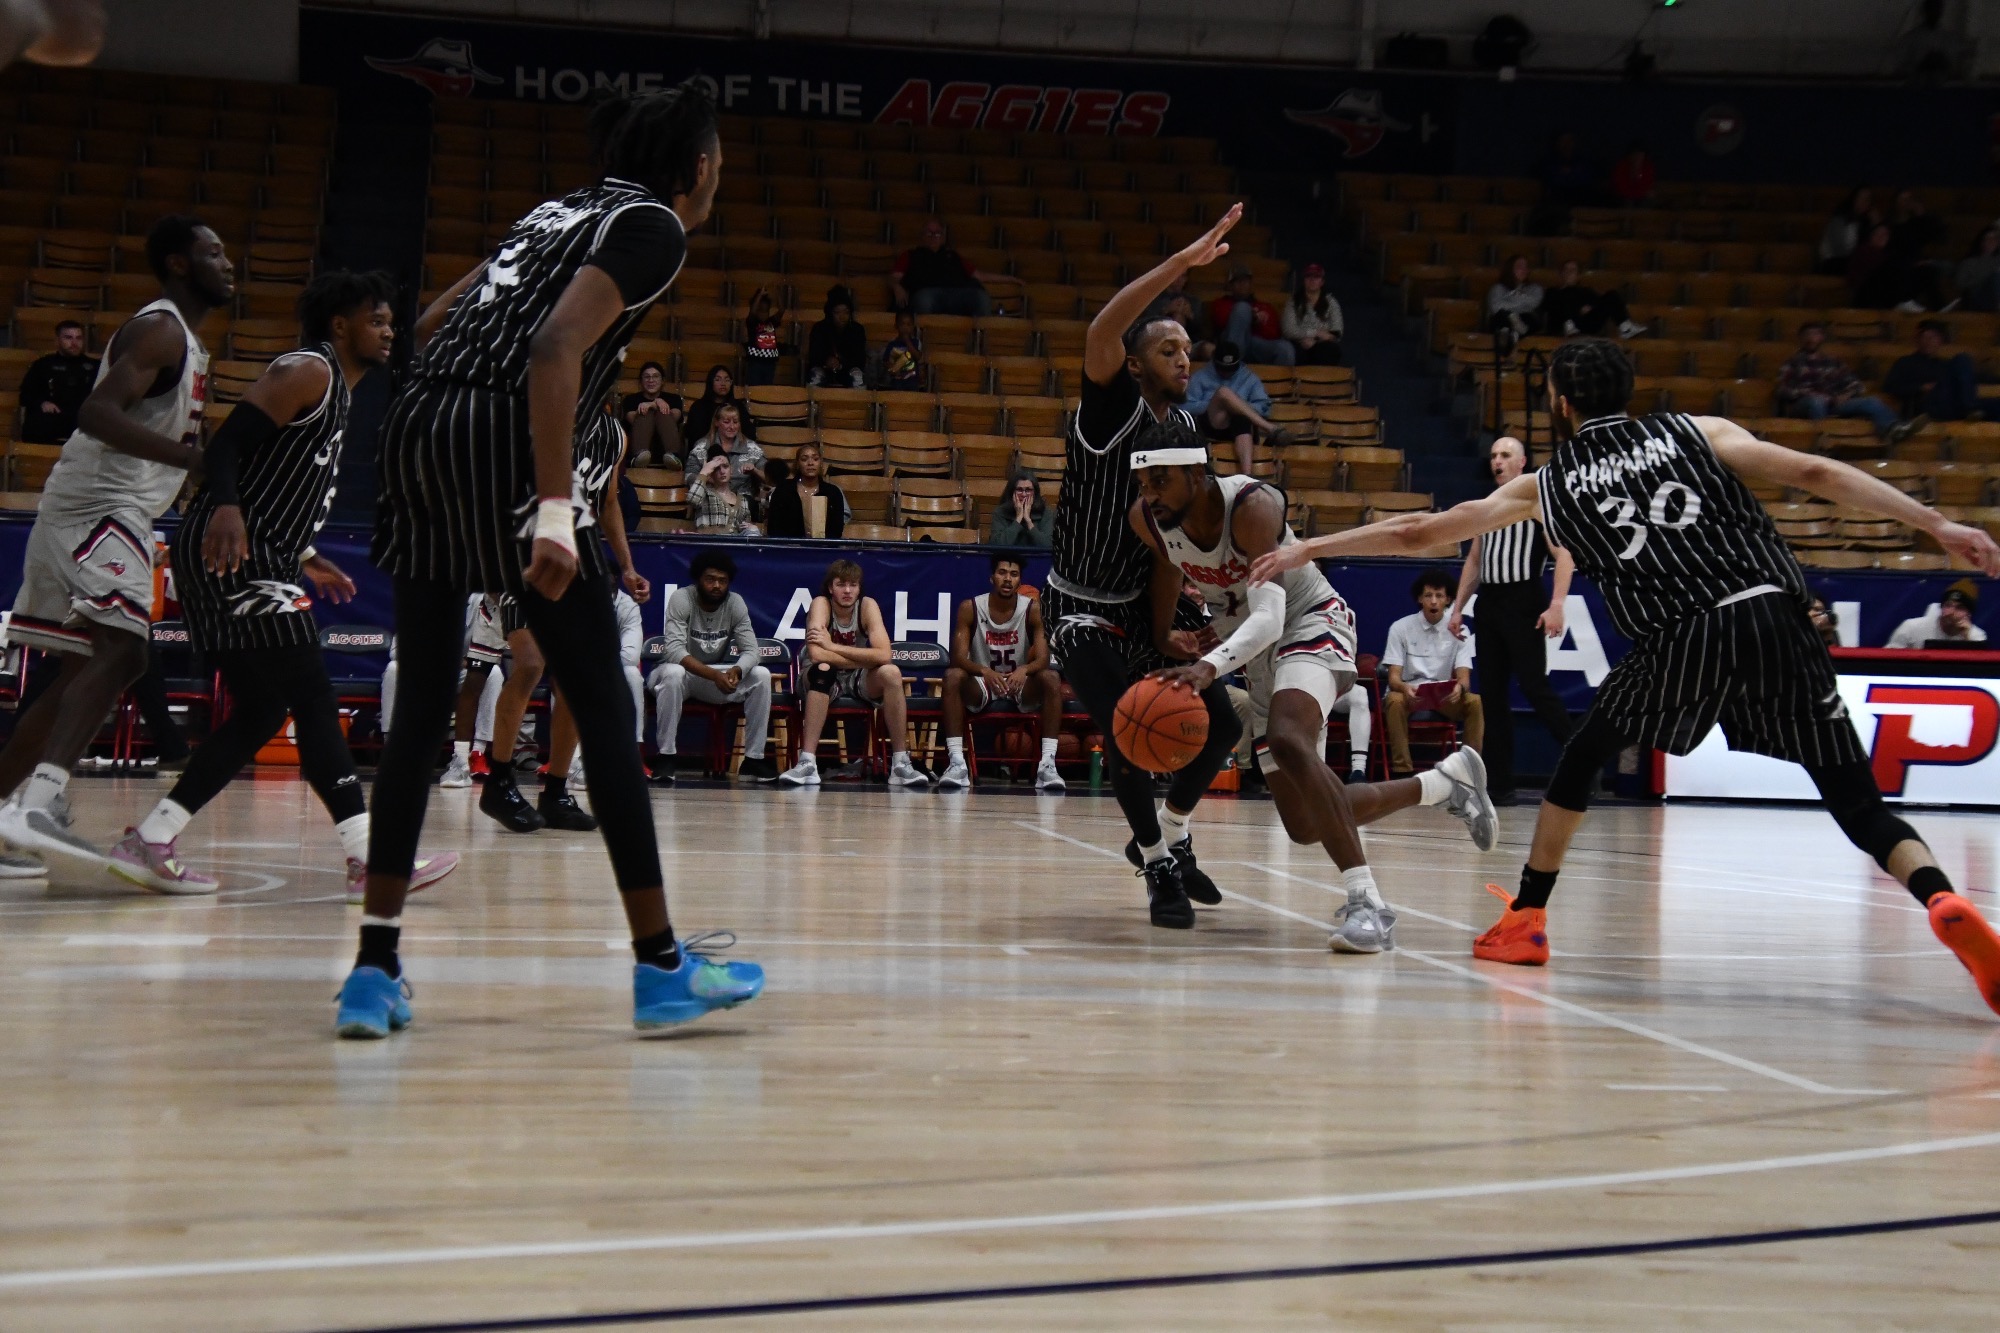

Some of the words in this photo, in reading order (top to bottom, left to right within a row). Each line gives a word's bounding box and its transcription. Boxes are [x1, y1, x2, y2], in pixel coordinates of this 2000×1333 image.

[768, 75, 864, 118] THE
[874, 78, 1171, 137] AGGIES
[1565, 432, 1678, 499] CHAPMAN
[1597, 480, 1702, 560] 30
[1181, 558, 1248, 589] AGGIES
[327, 633, 384, 646] AGGIES
[985, 630, 1019, 646] AGGIES
[891, 649, 941, 661] AGGIES
[990, 648, 1017, 674] 25
